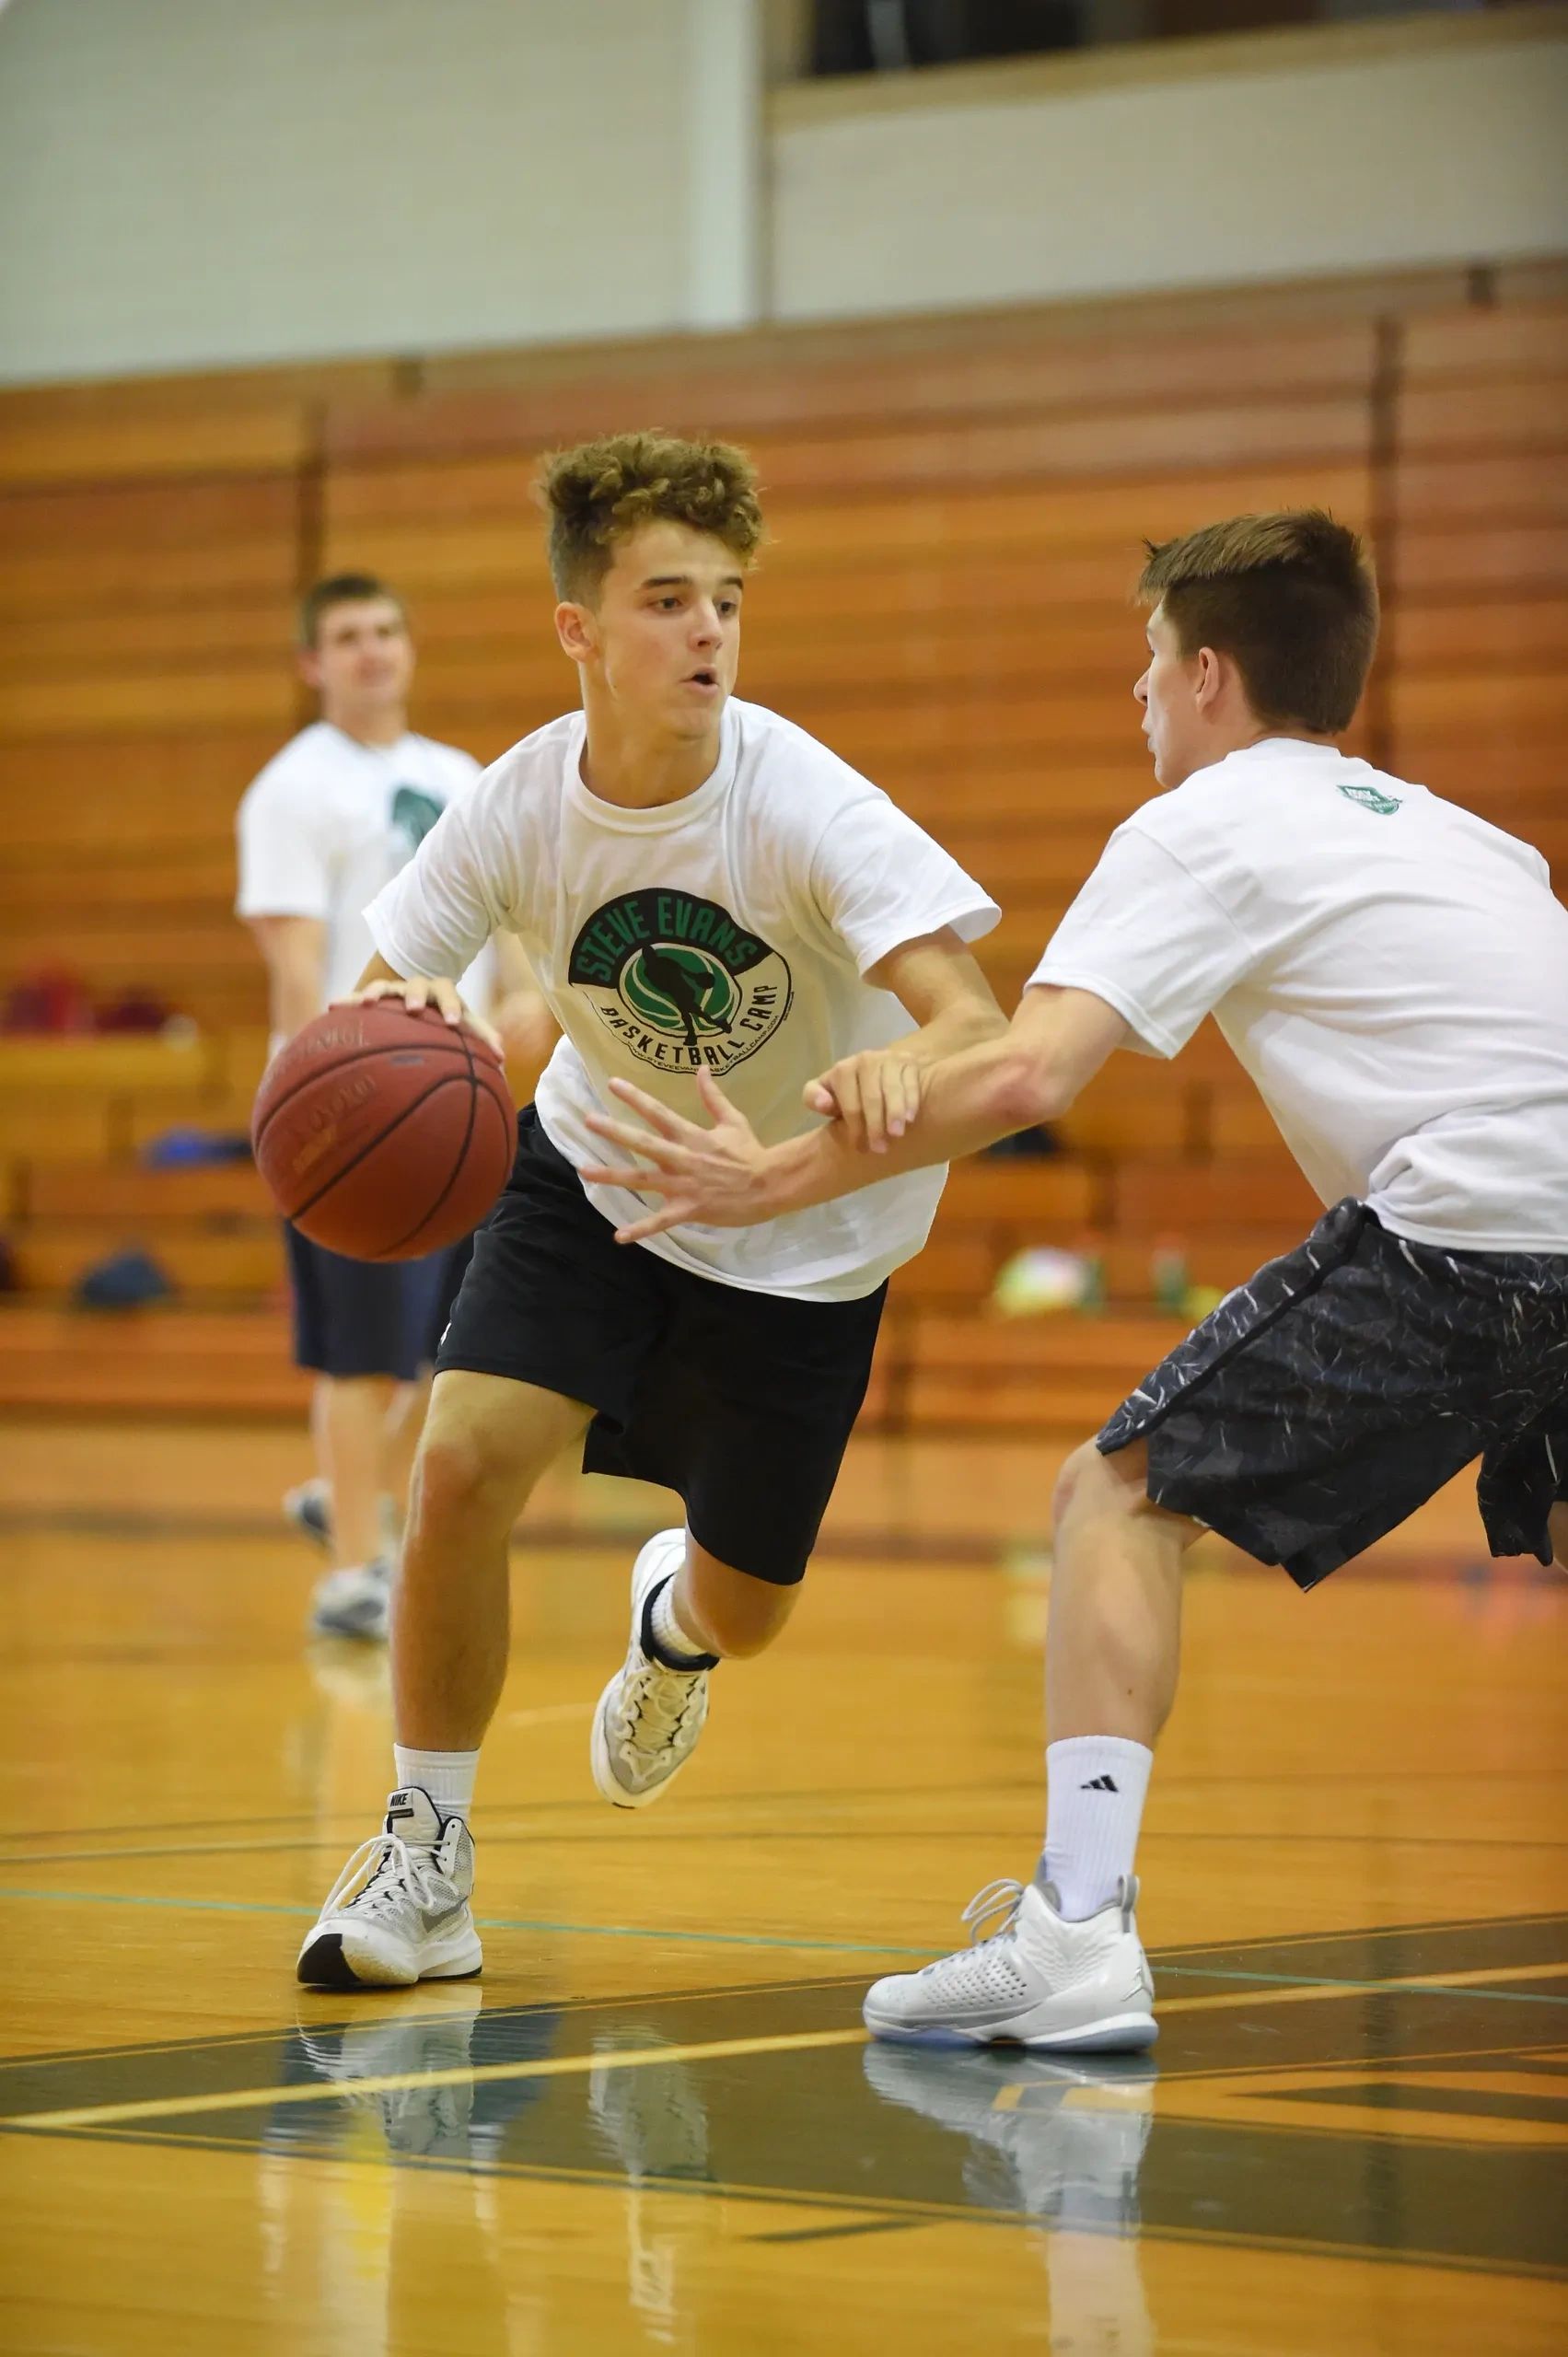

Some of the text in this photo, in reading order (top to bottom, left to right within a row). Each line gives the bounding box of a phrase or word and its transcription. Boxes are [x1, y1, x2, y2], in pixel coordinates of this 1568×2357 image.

[575, 896, 759, 982] STEVE EVANS
[601, 1006, 745, 1066] BASKETBALL
[739, 985, 778, 1031] CAMP
[390, 1793, 408, 1806] NIKE
